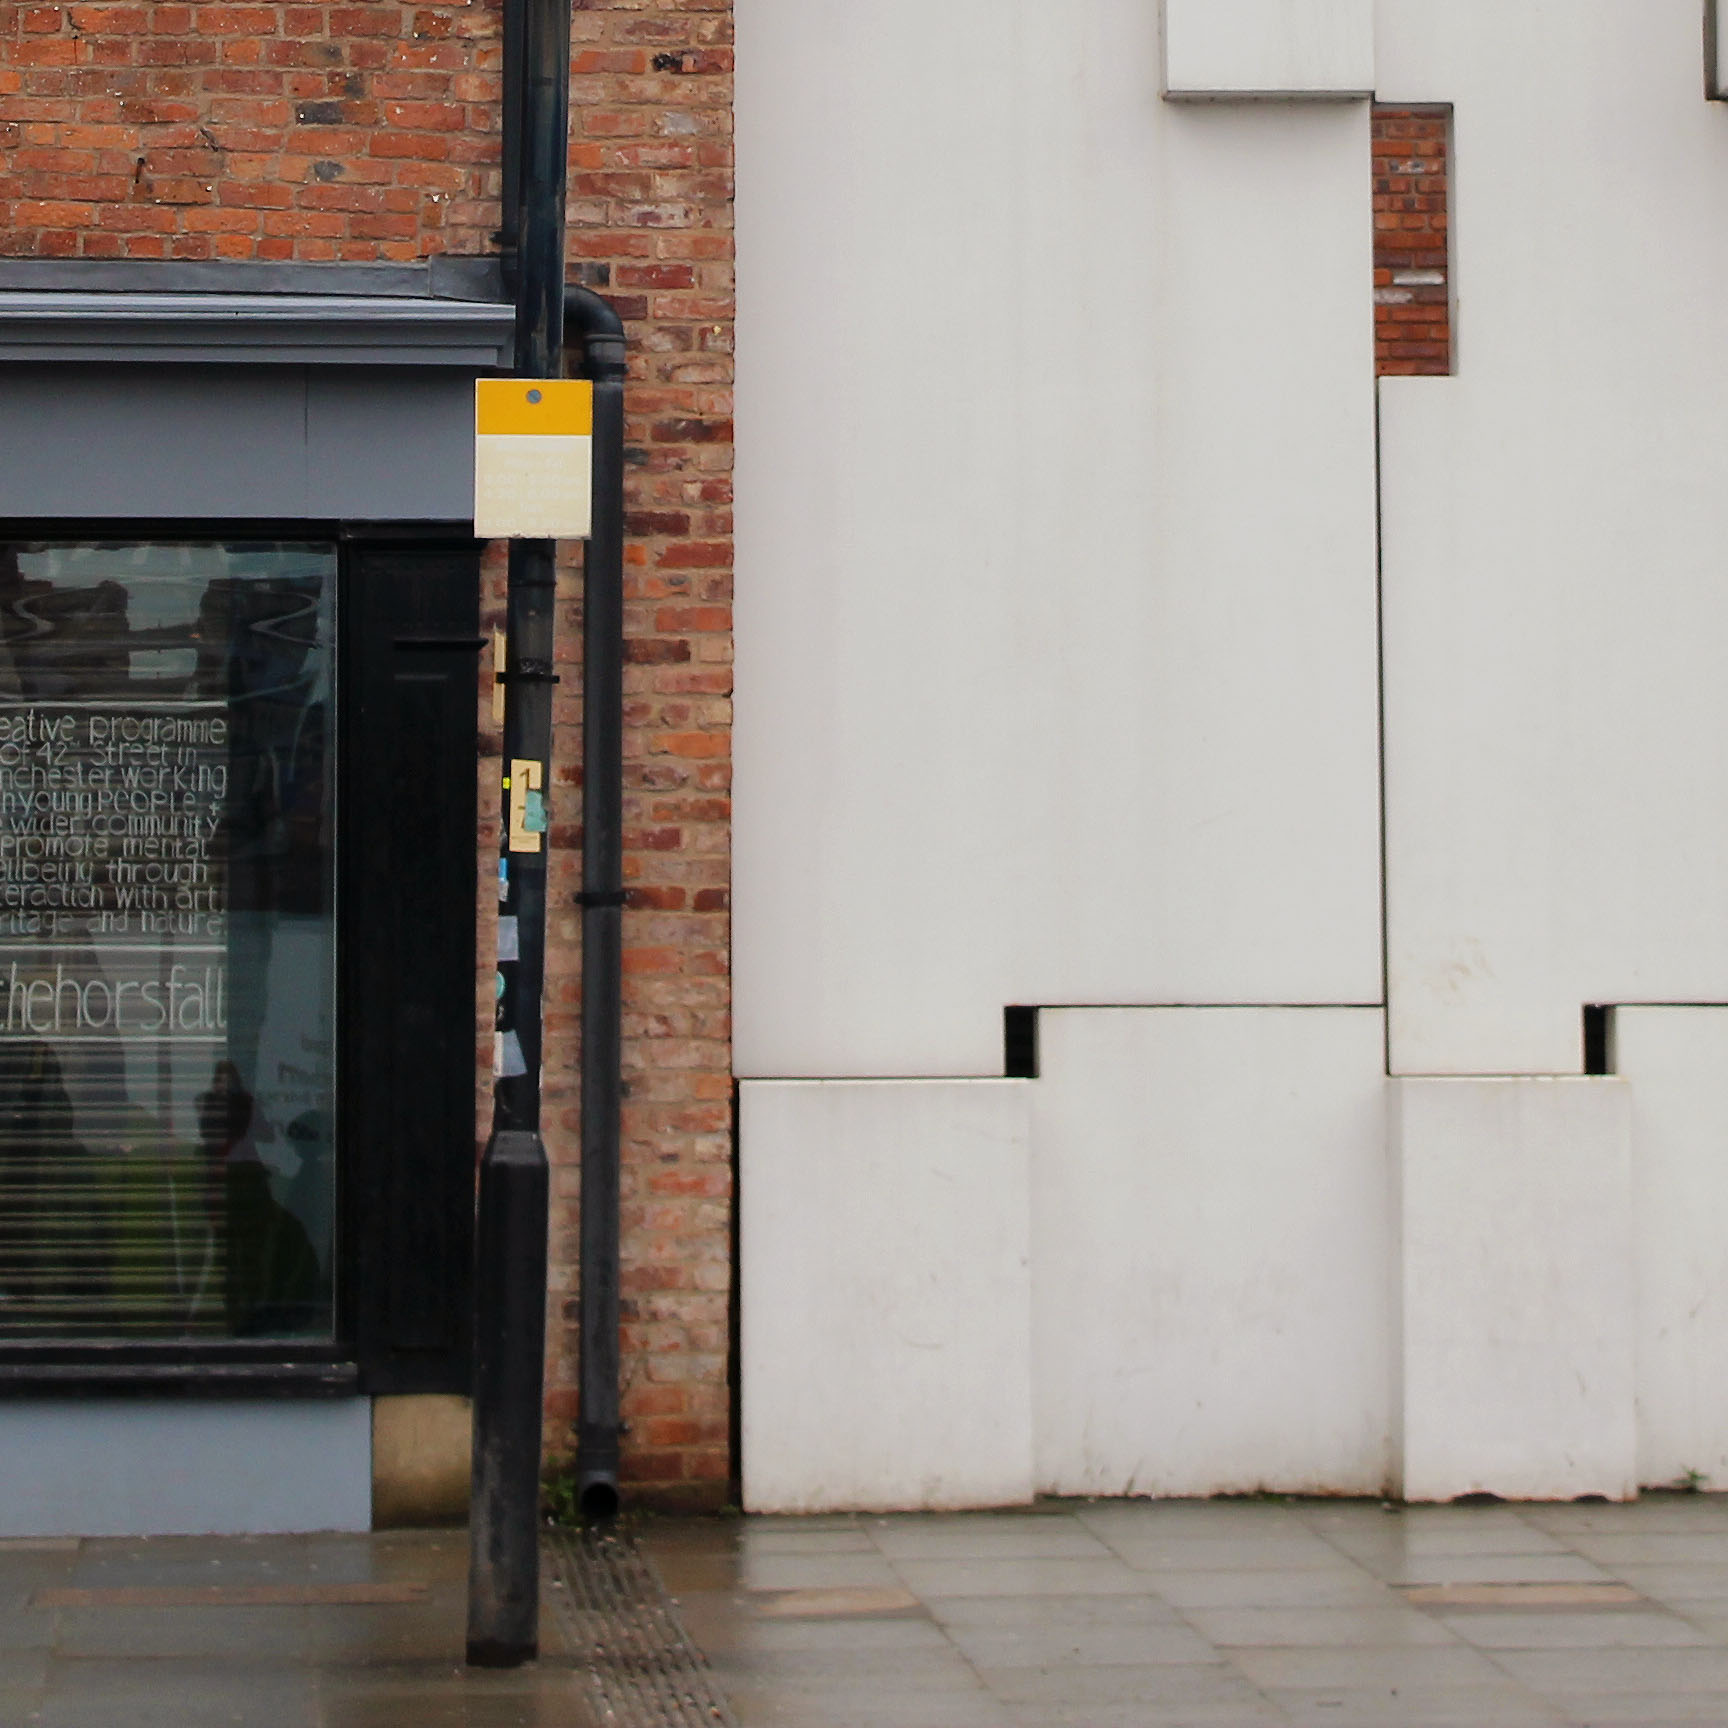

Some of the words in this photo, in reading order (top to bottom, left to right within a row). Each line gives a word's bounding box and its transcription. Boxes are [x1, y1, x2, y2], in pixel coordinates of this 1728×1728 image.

[89, 716, 227, 746] programme
[90, 741, 169, 766] Street
[177, 745, 197, 766] in
[10, 812, 79, 836] wider
[92, 813, 220, 840] community
[122, 834, 210, 860] mental
[105, 856, 208, 884] through
[115, 885, 168, 909] with
[87, 909, 129, 933] and
